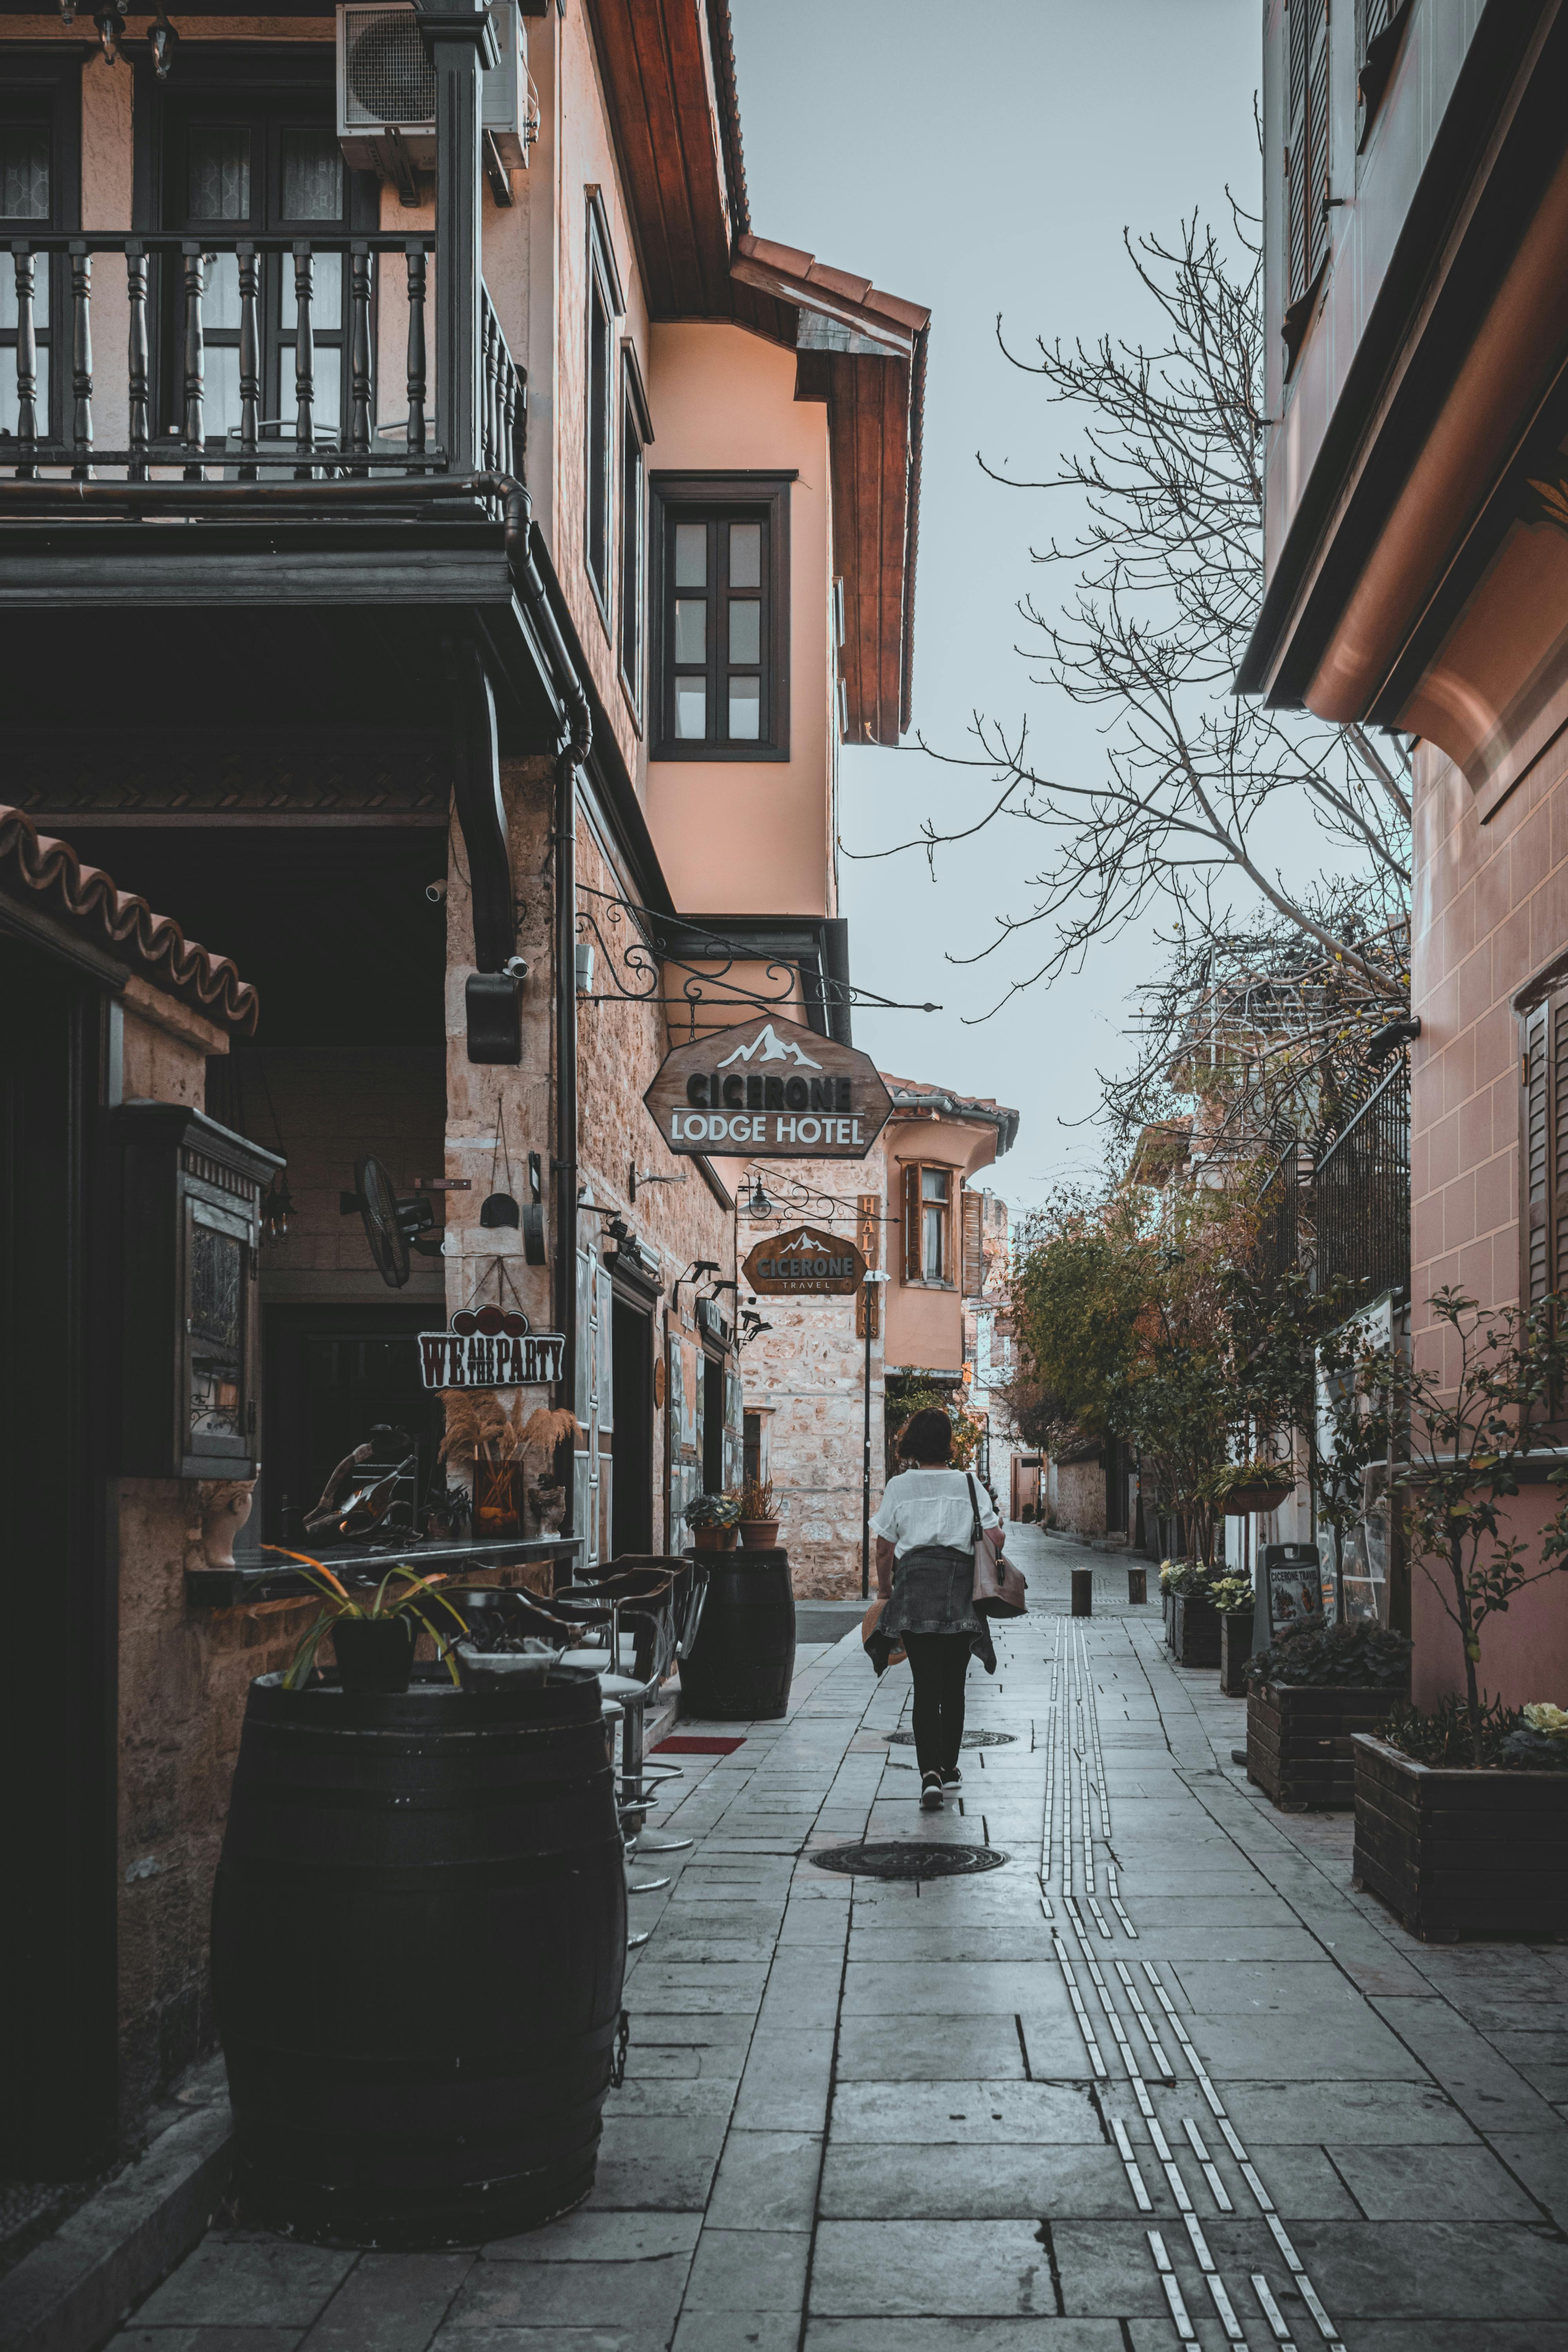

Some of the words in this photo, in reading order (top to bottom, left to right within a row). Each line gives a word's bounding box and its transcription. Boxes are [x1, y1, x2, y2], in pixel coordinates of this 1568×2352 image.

[686, 1073, 851, 1110] CICERONE
[672, 1114, 766, 1142] LODGE
[777, 1117, 864, 1145] HOTEL
[757, 1257, 853, 1277] CICERONE
[421, 1336, 465, 1387] WE
[468, 1338, 494, 1361] ARE
[496, 1339, 563, 1383] PARTY
[468, 1361, 494, 1385] THE
[1271, 1571, 1298, 1582] CICERONE
[1299, 1570, 1317, 1581] TRAVEL
